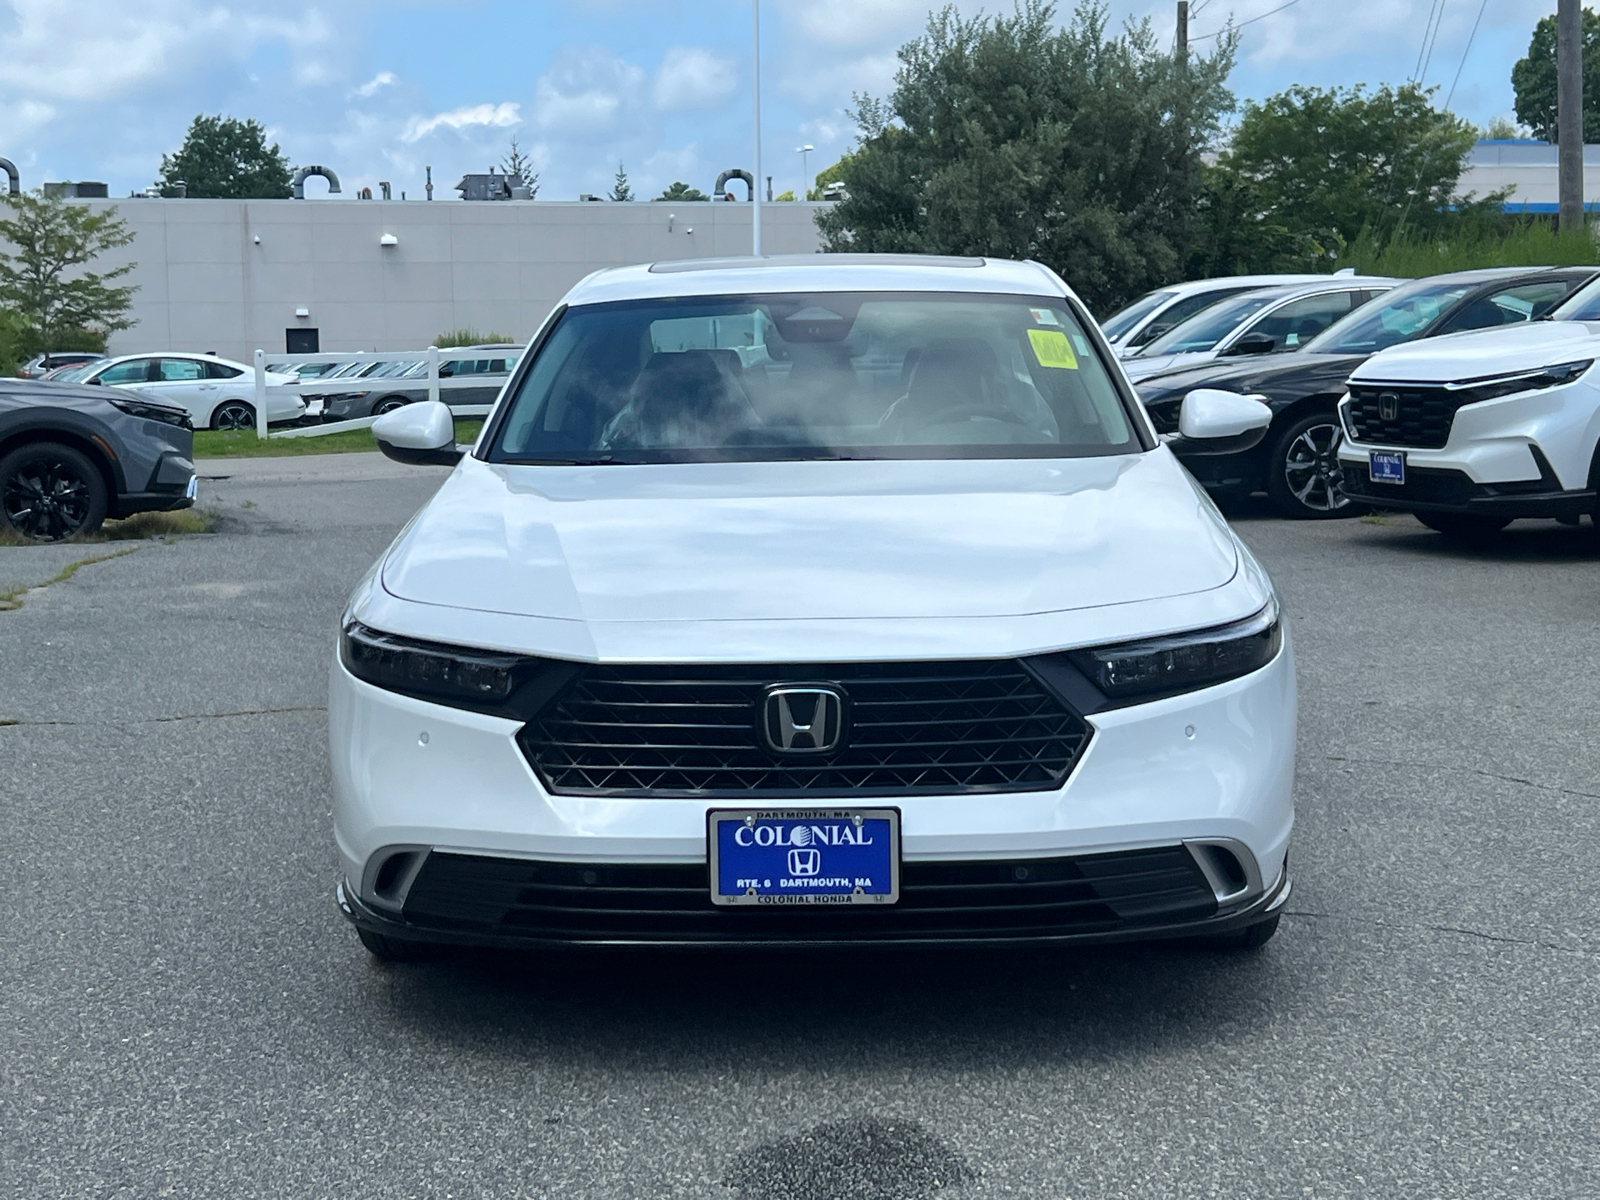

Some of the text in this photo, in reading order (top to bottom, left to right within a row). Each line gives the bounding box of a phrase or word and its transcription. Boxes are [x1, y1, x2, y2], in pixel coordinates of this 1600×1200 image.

[756, 811, 830, 819] DARTMOUTH,
[735, 825, 873, 846] COLONIAL
[736, 877, 872, 888] RTE. 6 DARTMOUTH, MA
[757, 895, 853, 904] COLONIAL HONDA
